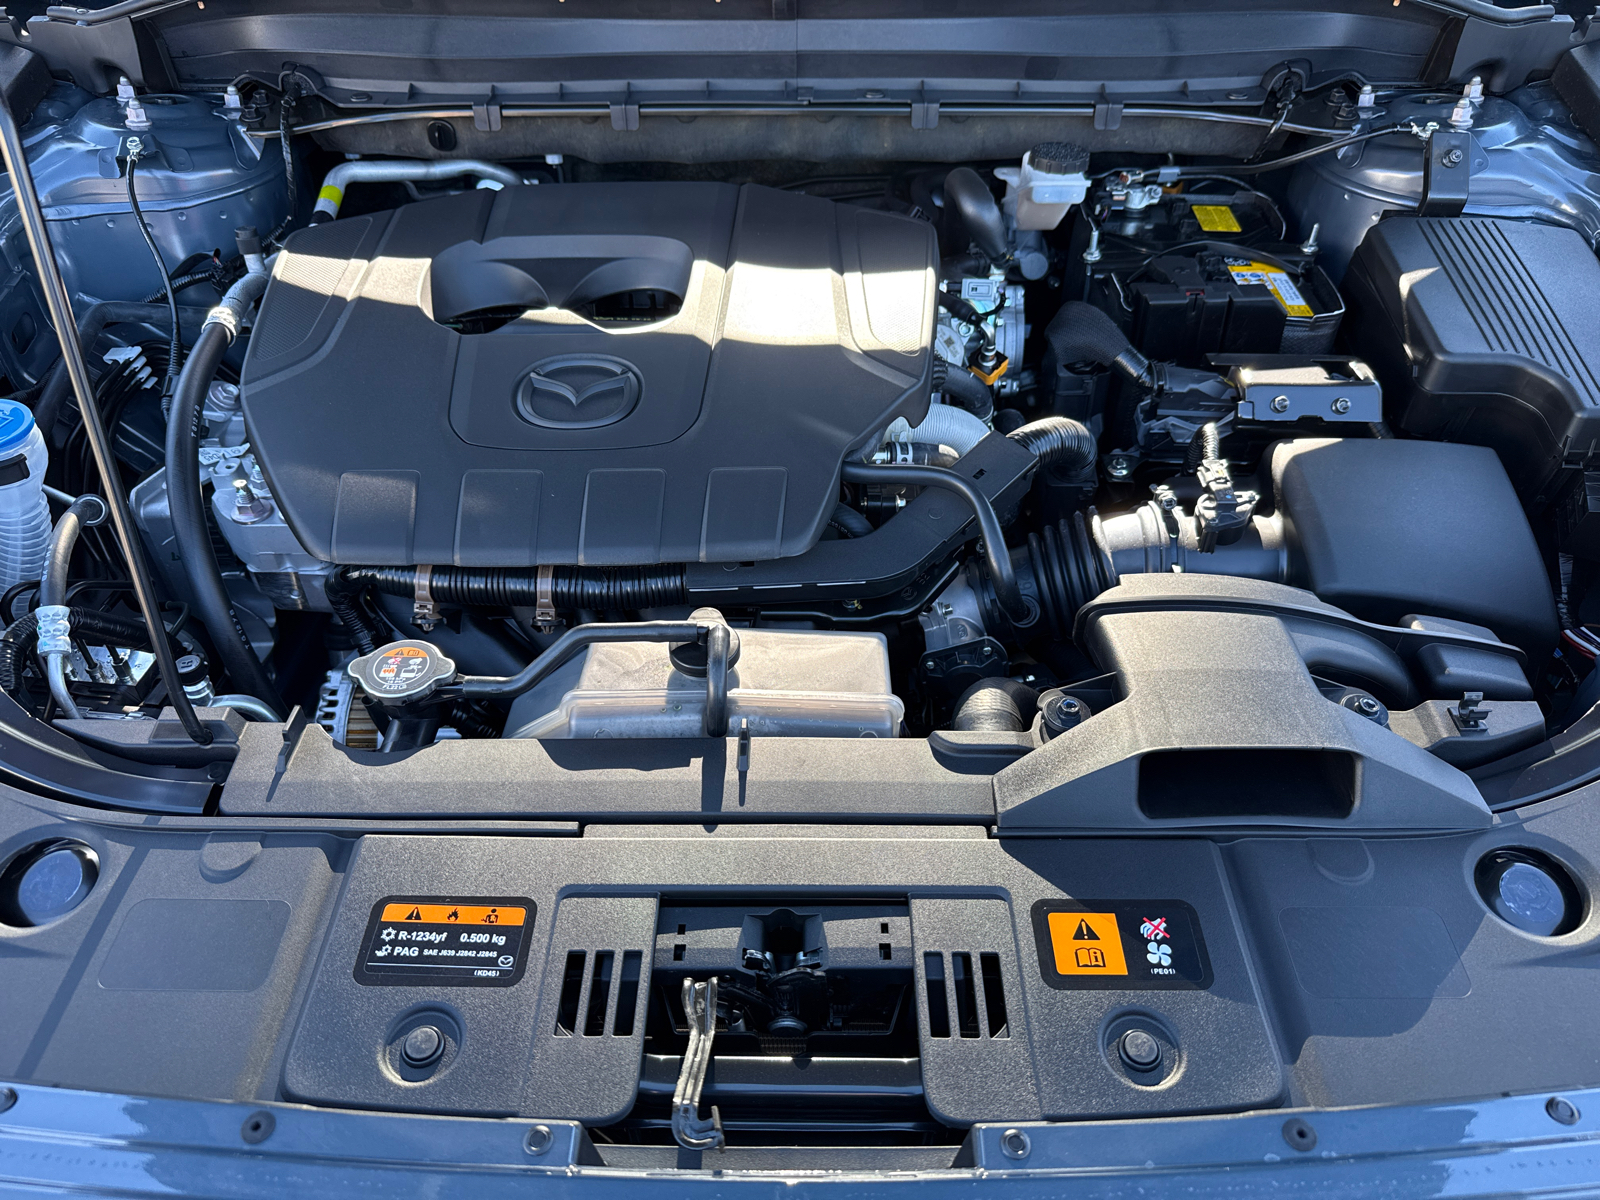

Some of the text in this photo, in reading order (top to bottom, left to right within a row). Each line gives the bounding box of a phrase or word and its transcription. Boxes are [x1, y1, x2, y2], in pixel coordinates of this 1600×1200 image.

[398, 931, 506, 945] R-1234yf 0.500 kg
[393, 947, 419, 957] PAG
[438, 949, 455, 957] J639
